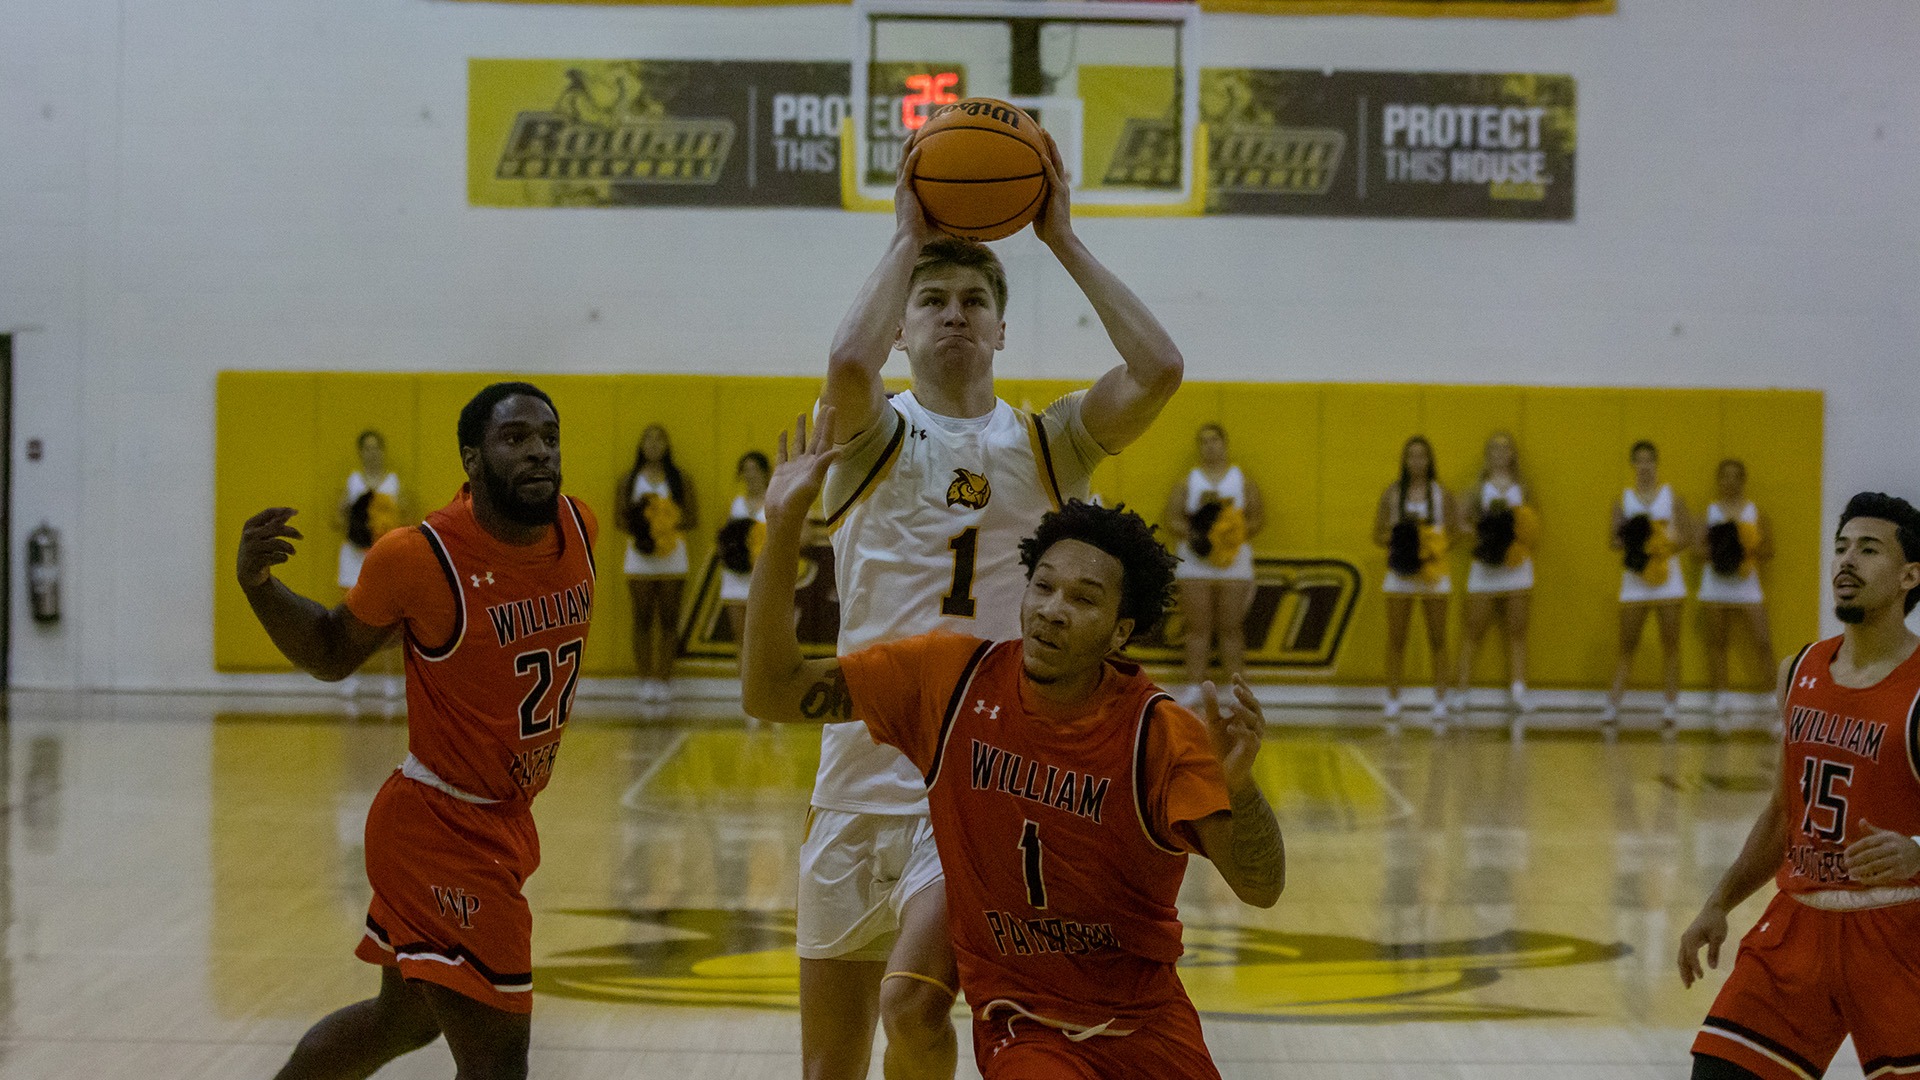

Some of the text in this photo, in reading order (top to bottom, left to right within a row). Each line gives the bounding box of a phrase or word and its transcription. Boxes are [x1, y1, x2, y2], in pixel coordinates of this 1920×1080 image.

[772, 138, 835, 173] THIS
[1383, 103, 1546, 149] PROTECT
[1384, 149, 1446, 184] THIS
[939, 525, 980, 620] 1
[486, 580, 591, 648] WILLIAM
[1788, 705, 1888, 764] WILLIAM
[971, 738, 1111, 825] WILLIAM
[1800, 756, 1855, 845] 15
[1017, 818, 1048, 910] 1
[431, 885, 481, 929] WP
